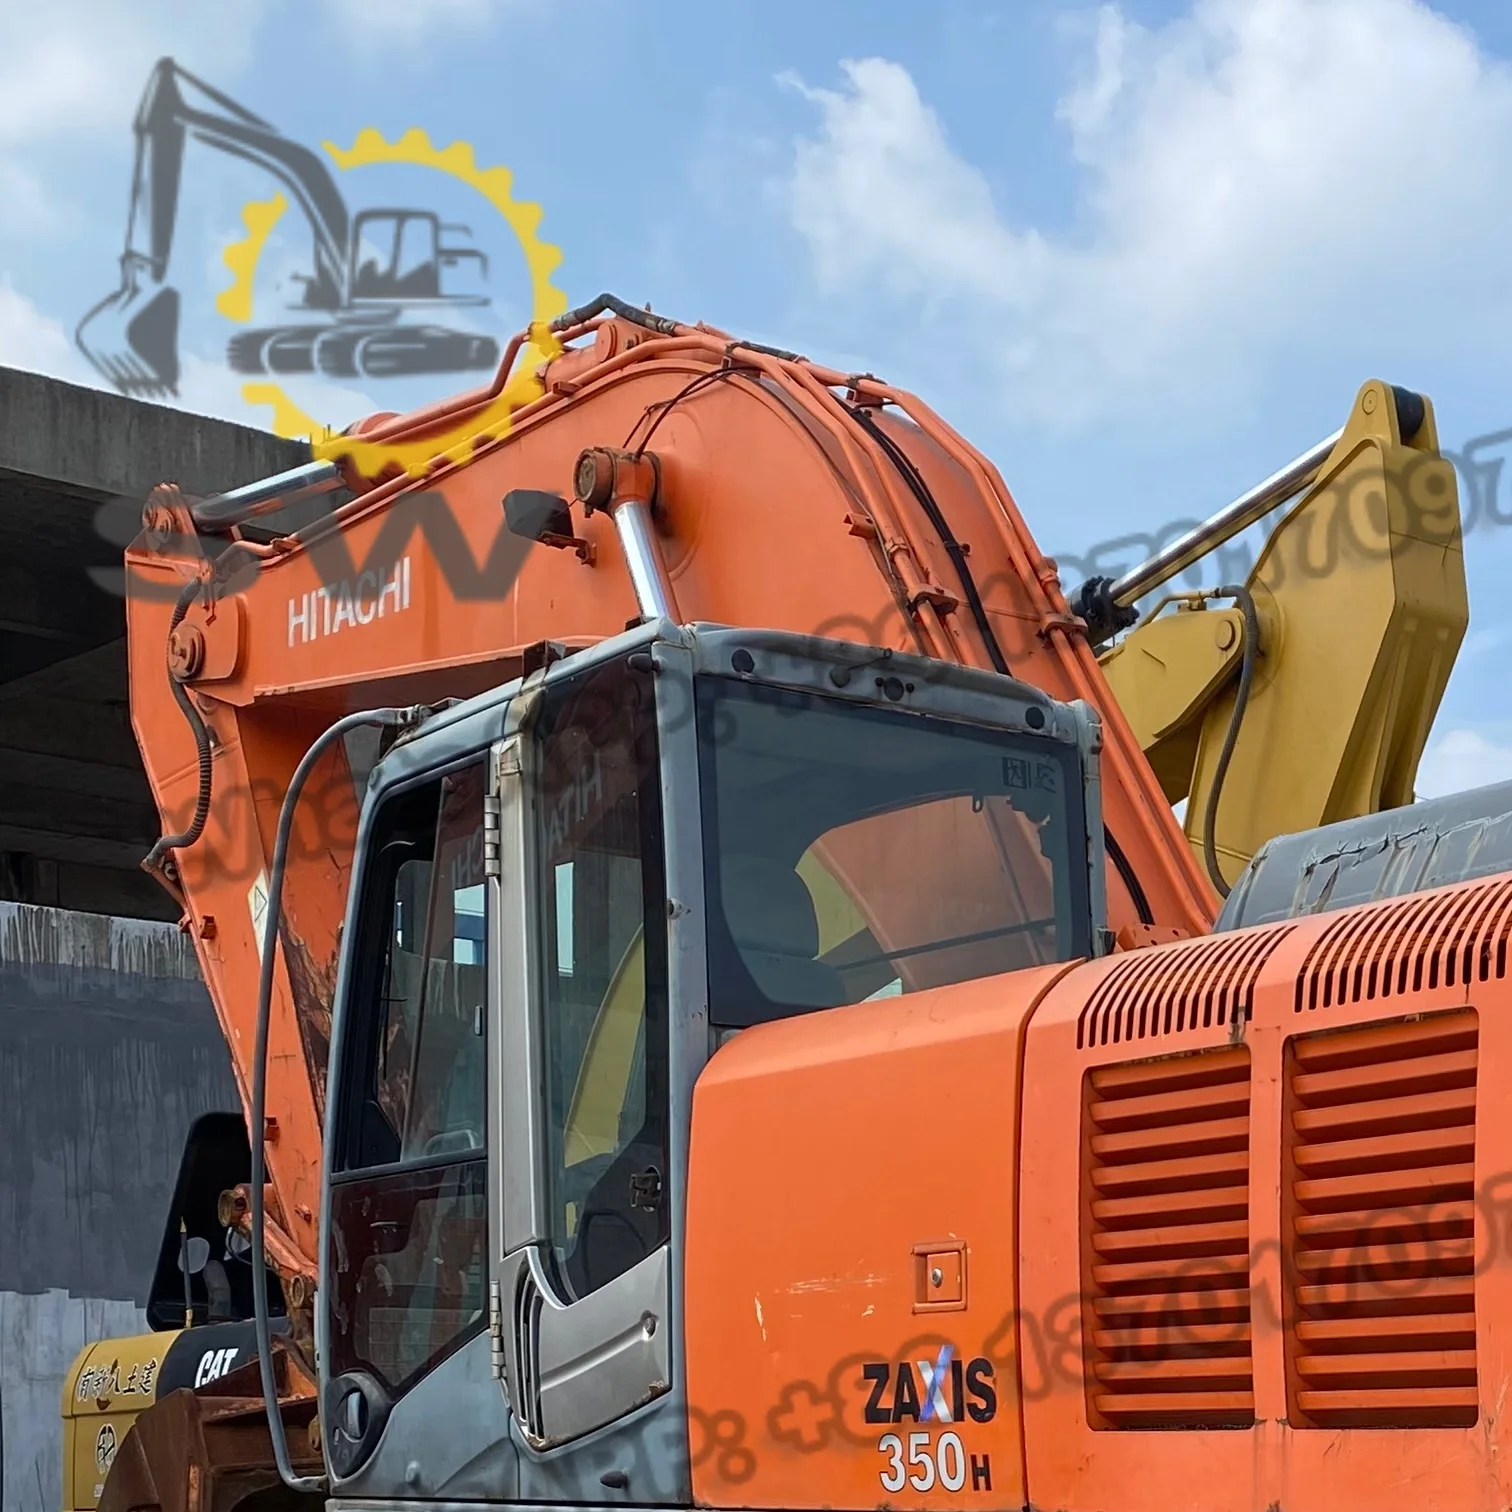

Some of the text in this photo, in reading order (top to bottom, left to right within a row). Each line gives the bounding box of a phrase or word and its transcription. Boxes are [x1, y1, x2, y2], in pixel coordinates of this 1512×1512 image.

[288, 557, 411, 647] HITACHI
[194, 1348, 239, 1389] CAT
[863, 1344, 997, 1424] ZAXIS
